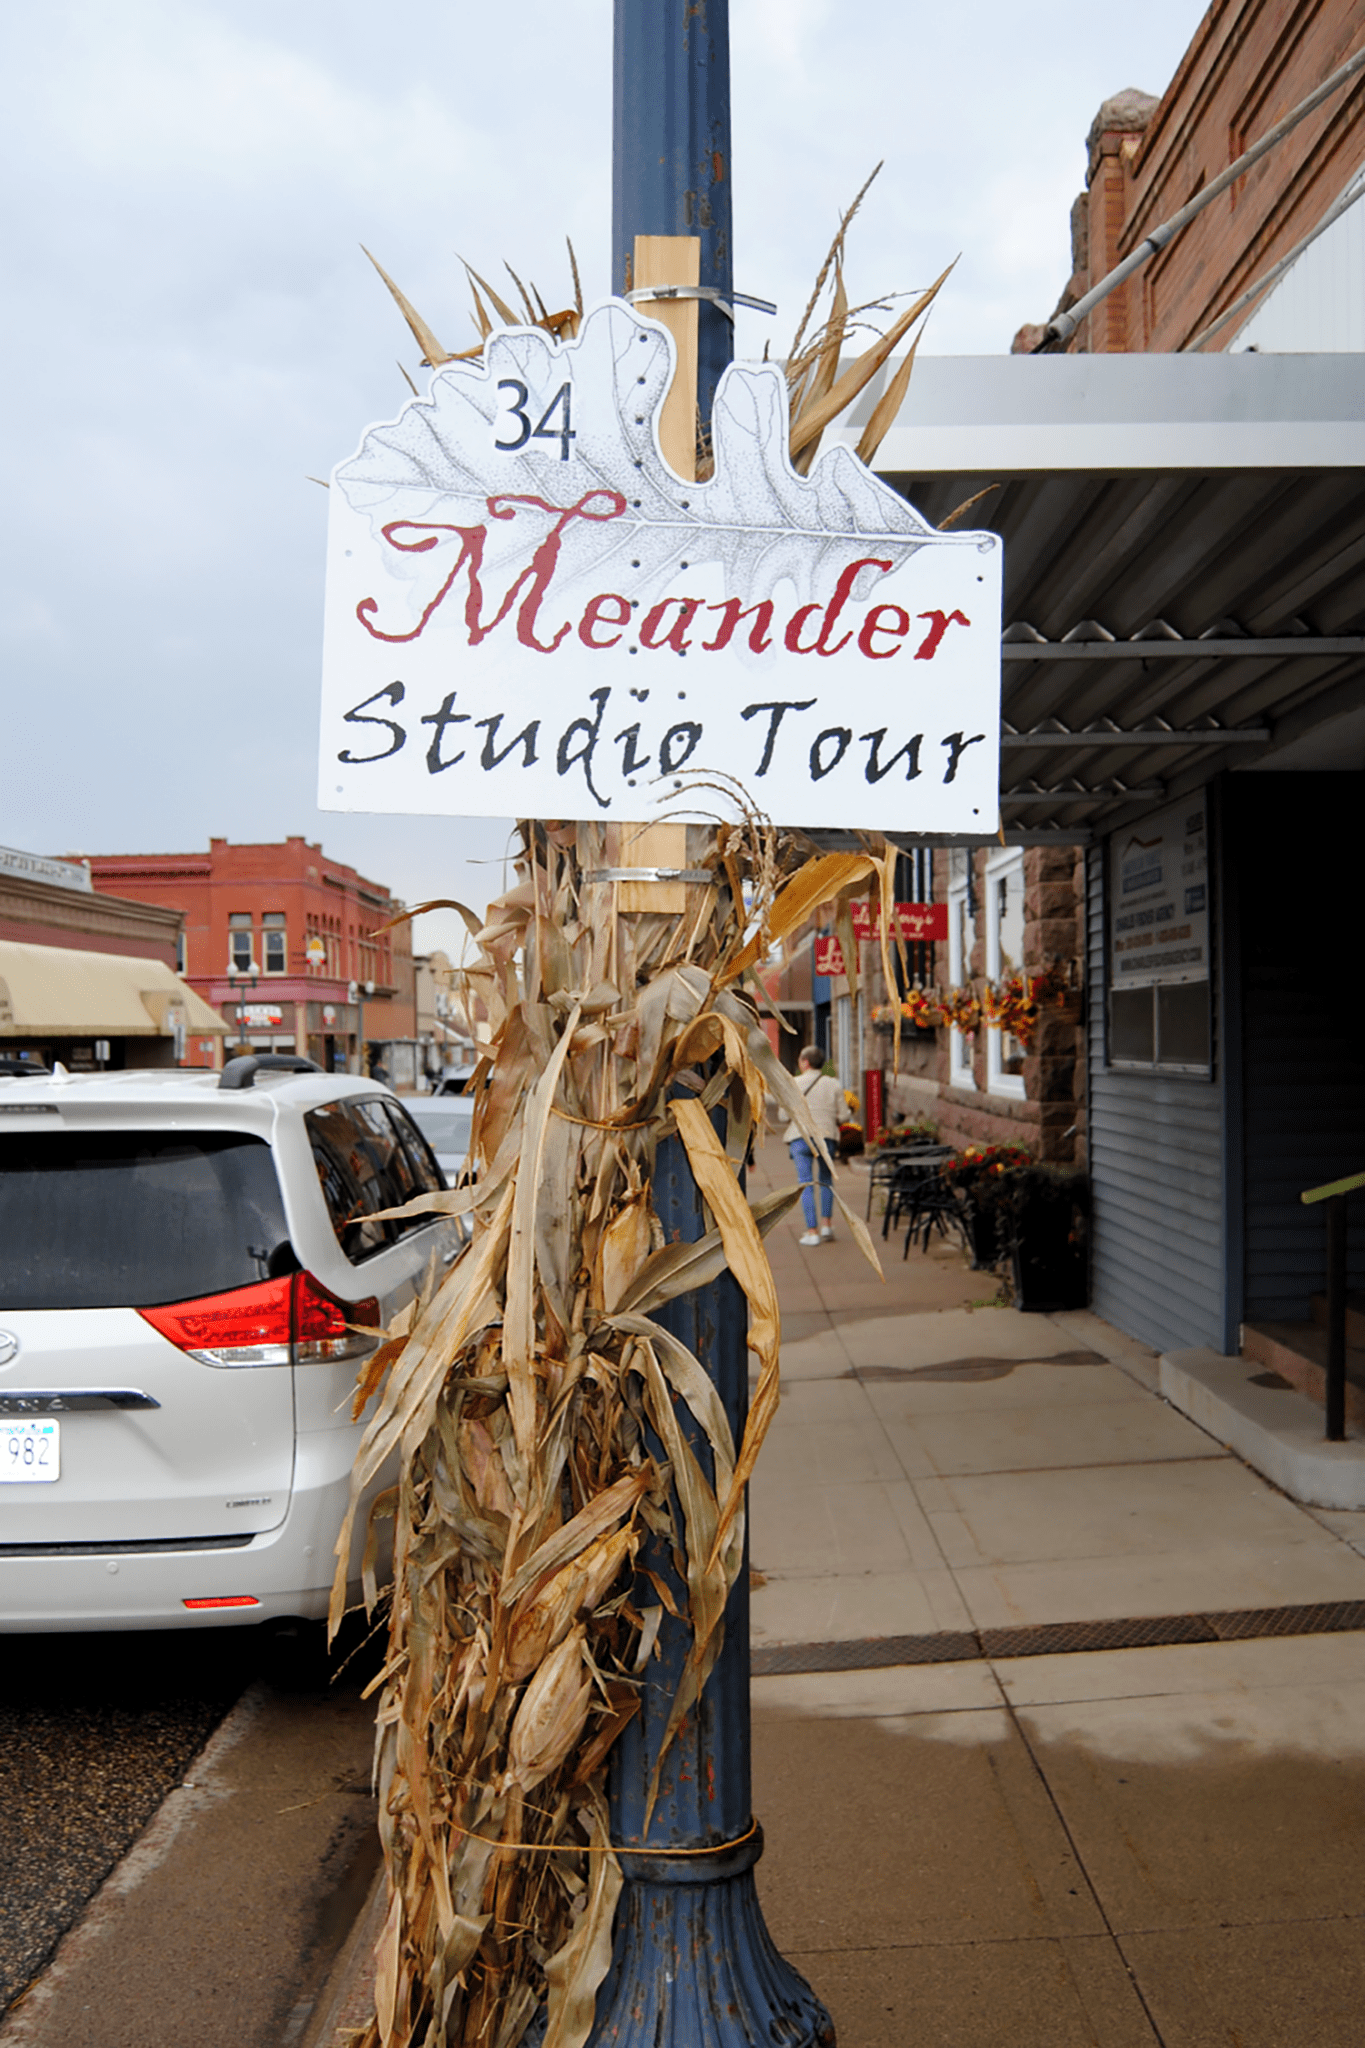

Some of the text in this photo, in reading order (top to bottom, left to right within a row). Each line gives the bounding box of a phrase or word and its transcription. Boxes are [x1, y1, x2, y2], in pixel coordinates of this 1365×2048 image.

[494, 379, 576, 461] 34
[356, 489, 971, 660] Meander
[337, 680, 985, 808] Studio Tour
[8, 1437, 50, 1466] 982
